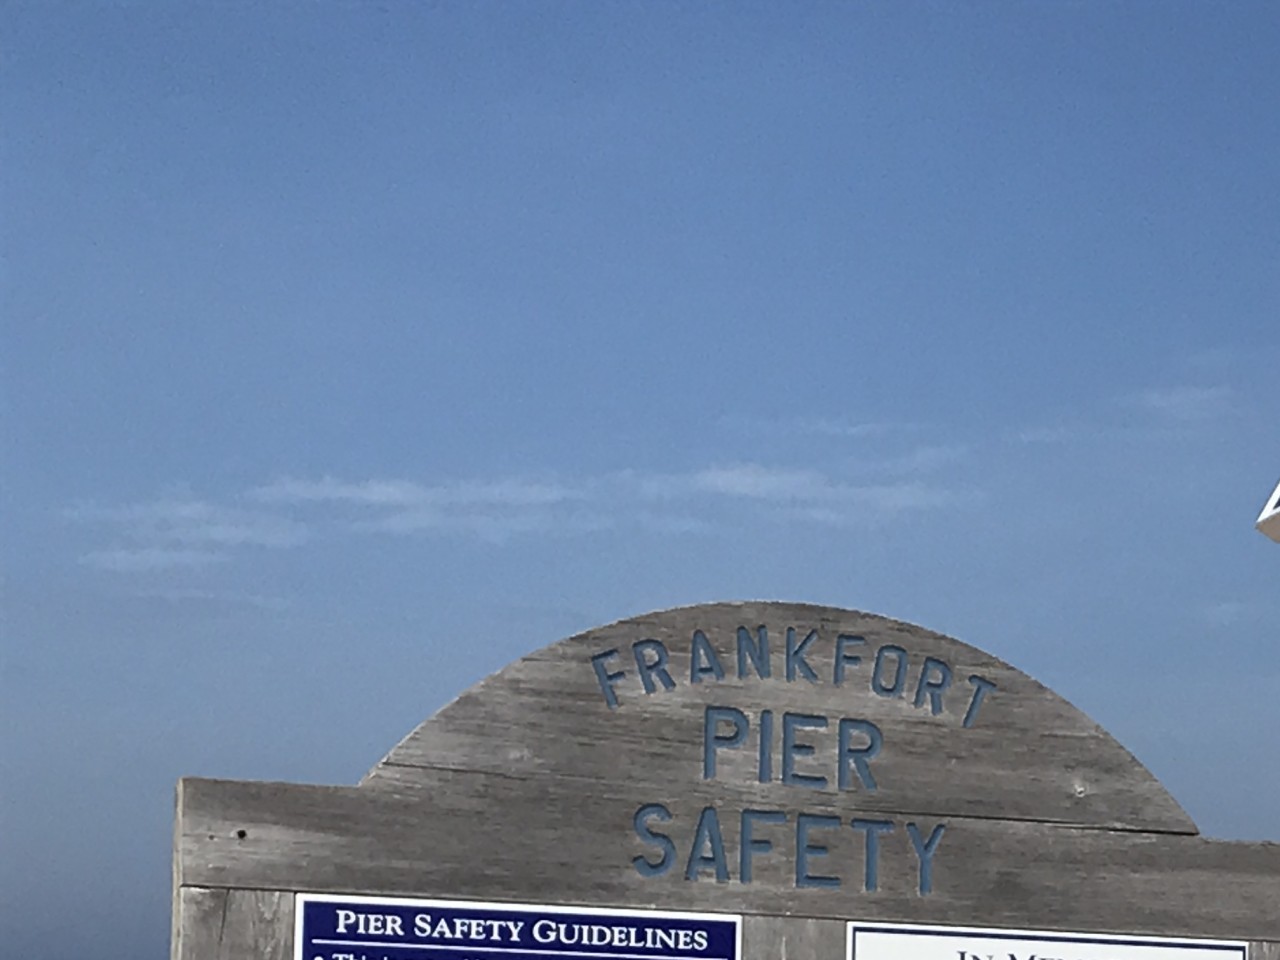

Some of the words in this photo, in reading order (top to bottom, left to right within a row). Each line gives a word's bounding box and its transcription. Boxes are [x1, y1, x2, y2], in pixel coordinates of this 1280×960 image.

[591, 624, 998, 729] FRANKFORT
[703, 705, 884, 791] PIER
[632, 803, 946, 896] SAFETY
[335, 909, 405, 936] PIER
[413, 913, 524, 942] SAFETY
[531, 919, 708, 951] GUIDELINES
